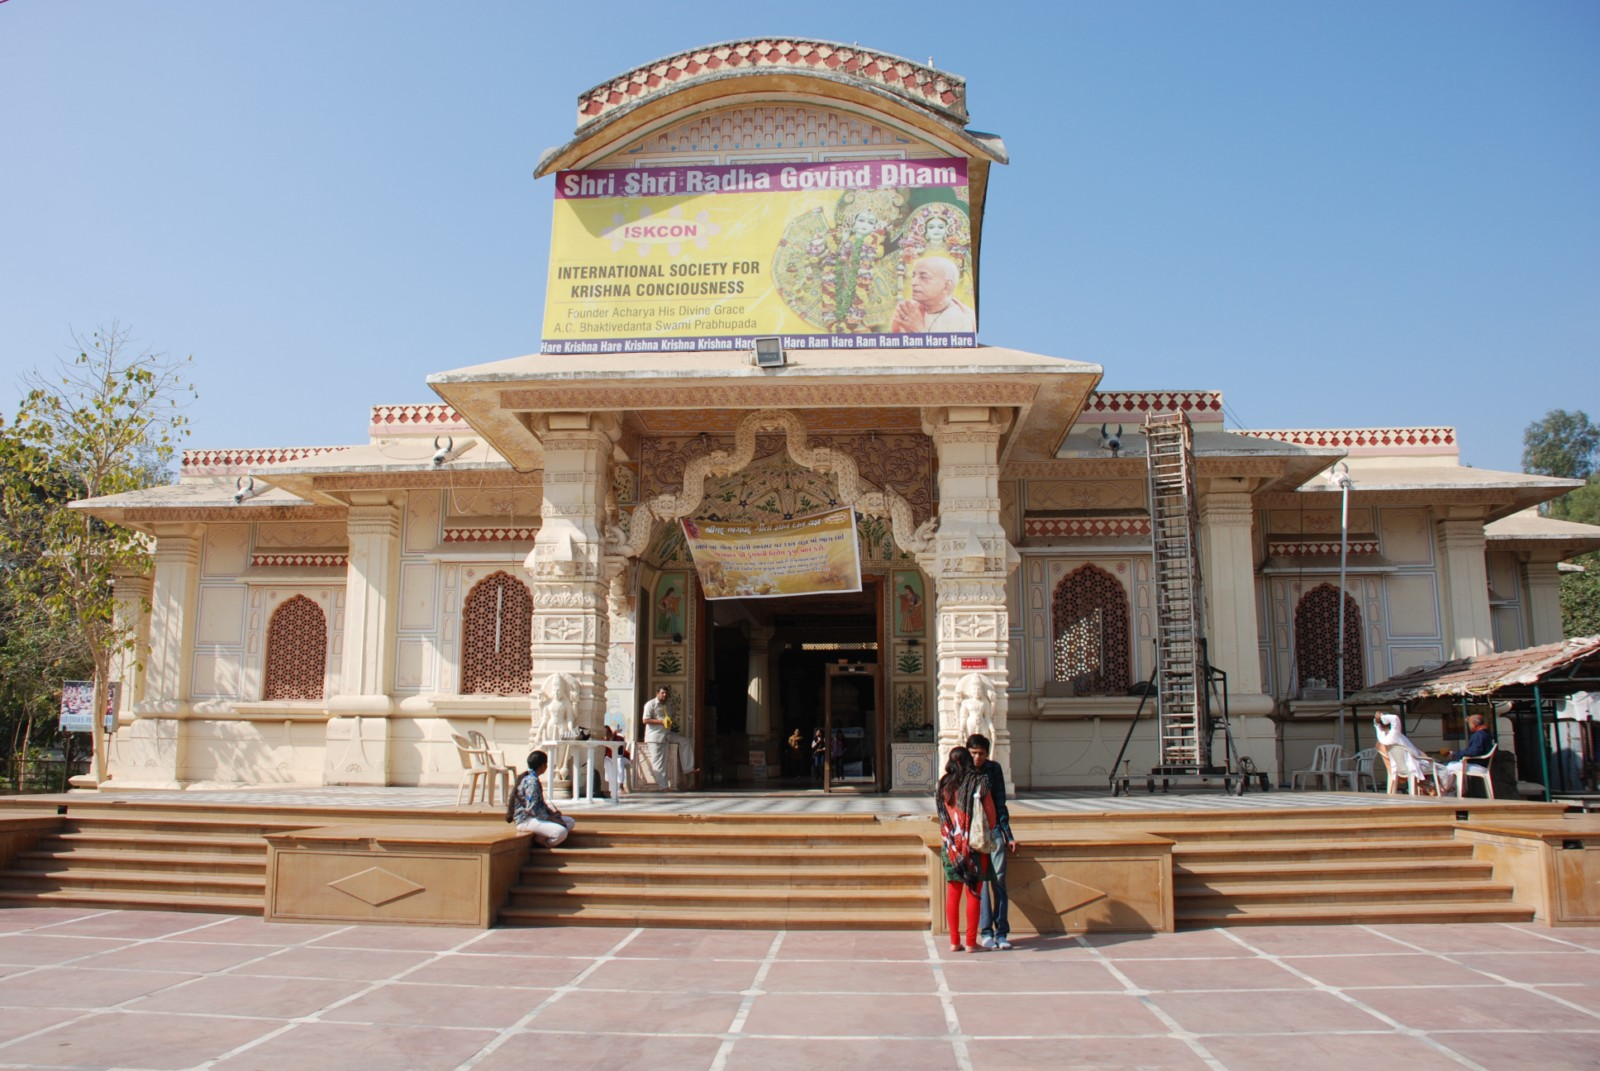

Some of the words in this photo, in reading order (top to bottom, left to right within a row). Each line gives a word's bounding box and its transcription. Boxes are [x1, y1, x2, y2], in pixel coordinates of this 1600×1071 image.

[564, 173, 614, 196] Shri
[625, 172, 675, 193] Shri
[687, 169, 770, 191] Radha
[781, 166, 870, 188] Govind
[882, 164, 956, 185] Dham
[625, 225, 697, 238] ISKCON
[558, 265, 664, 279] INTERNATIONAL
[670, 263, 727, 277] SOCIETY
[733, 261, 759, 275] FOR
[571, 285, 631, 297] KRISHNA
[636, 281, 744, 296] CONCIOUSNESS
[568, 308, 608, 318] Founder
[612, 306, 655, 319] Acharya
[659, 306, 675, 316] His
[679, 305, 710, 315] Divine
[715, 305, 744, 314] Grace
[554, 323, 575, 333] A.C.
[580, 321, 651, 332] Bhaktivedanta
[656, 320, 691, 331] Swami
[694, 318, 757, 331] Prabhupada
[541, 342, 561, 352] Hare
[565, 340, 597, 352] Krishna
[601, 341, 621, 351] Hare
[625, 339, 658, 350] Krishna
[661, 339, 695, 350] Krishna
[698, 338, 731, 349] Krishna
[735, 338, 756, 348] Hare
[784, 337, 805, 348] Hare
[809, 337, 828, 347] Ram
[831, 337, 853, 347] Hare
[856, 336, 876, 347] Ram
[879, 336, 899, 346] Ram
[903, 336, 923, 346] Ram
[926, 335, 948, 346] Hare
[951, 335, 972, 346] Hare
